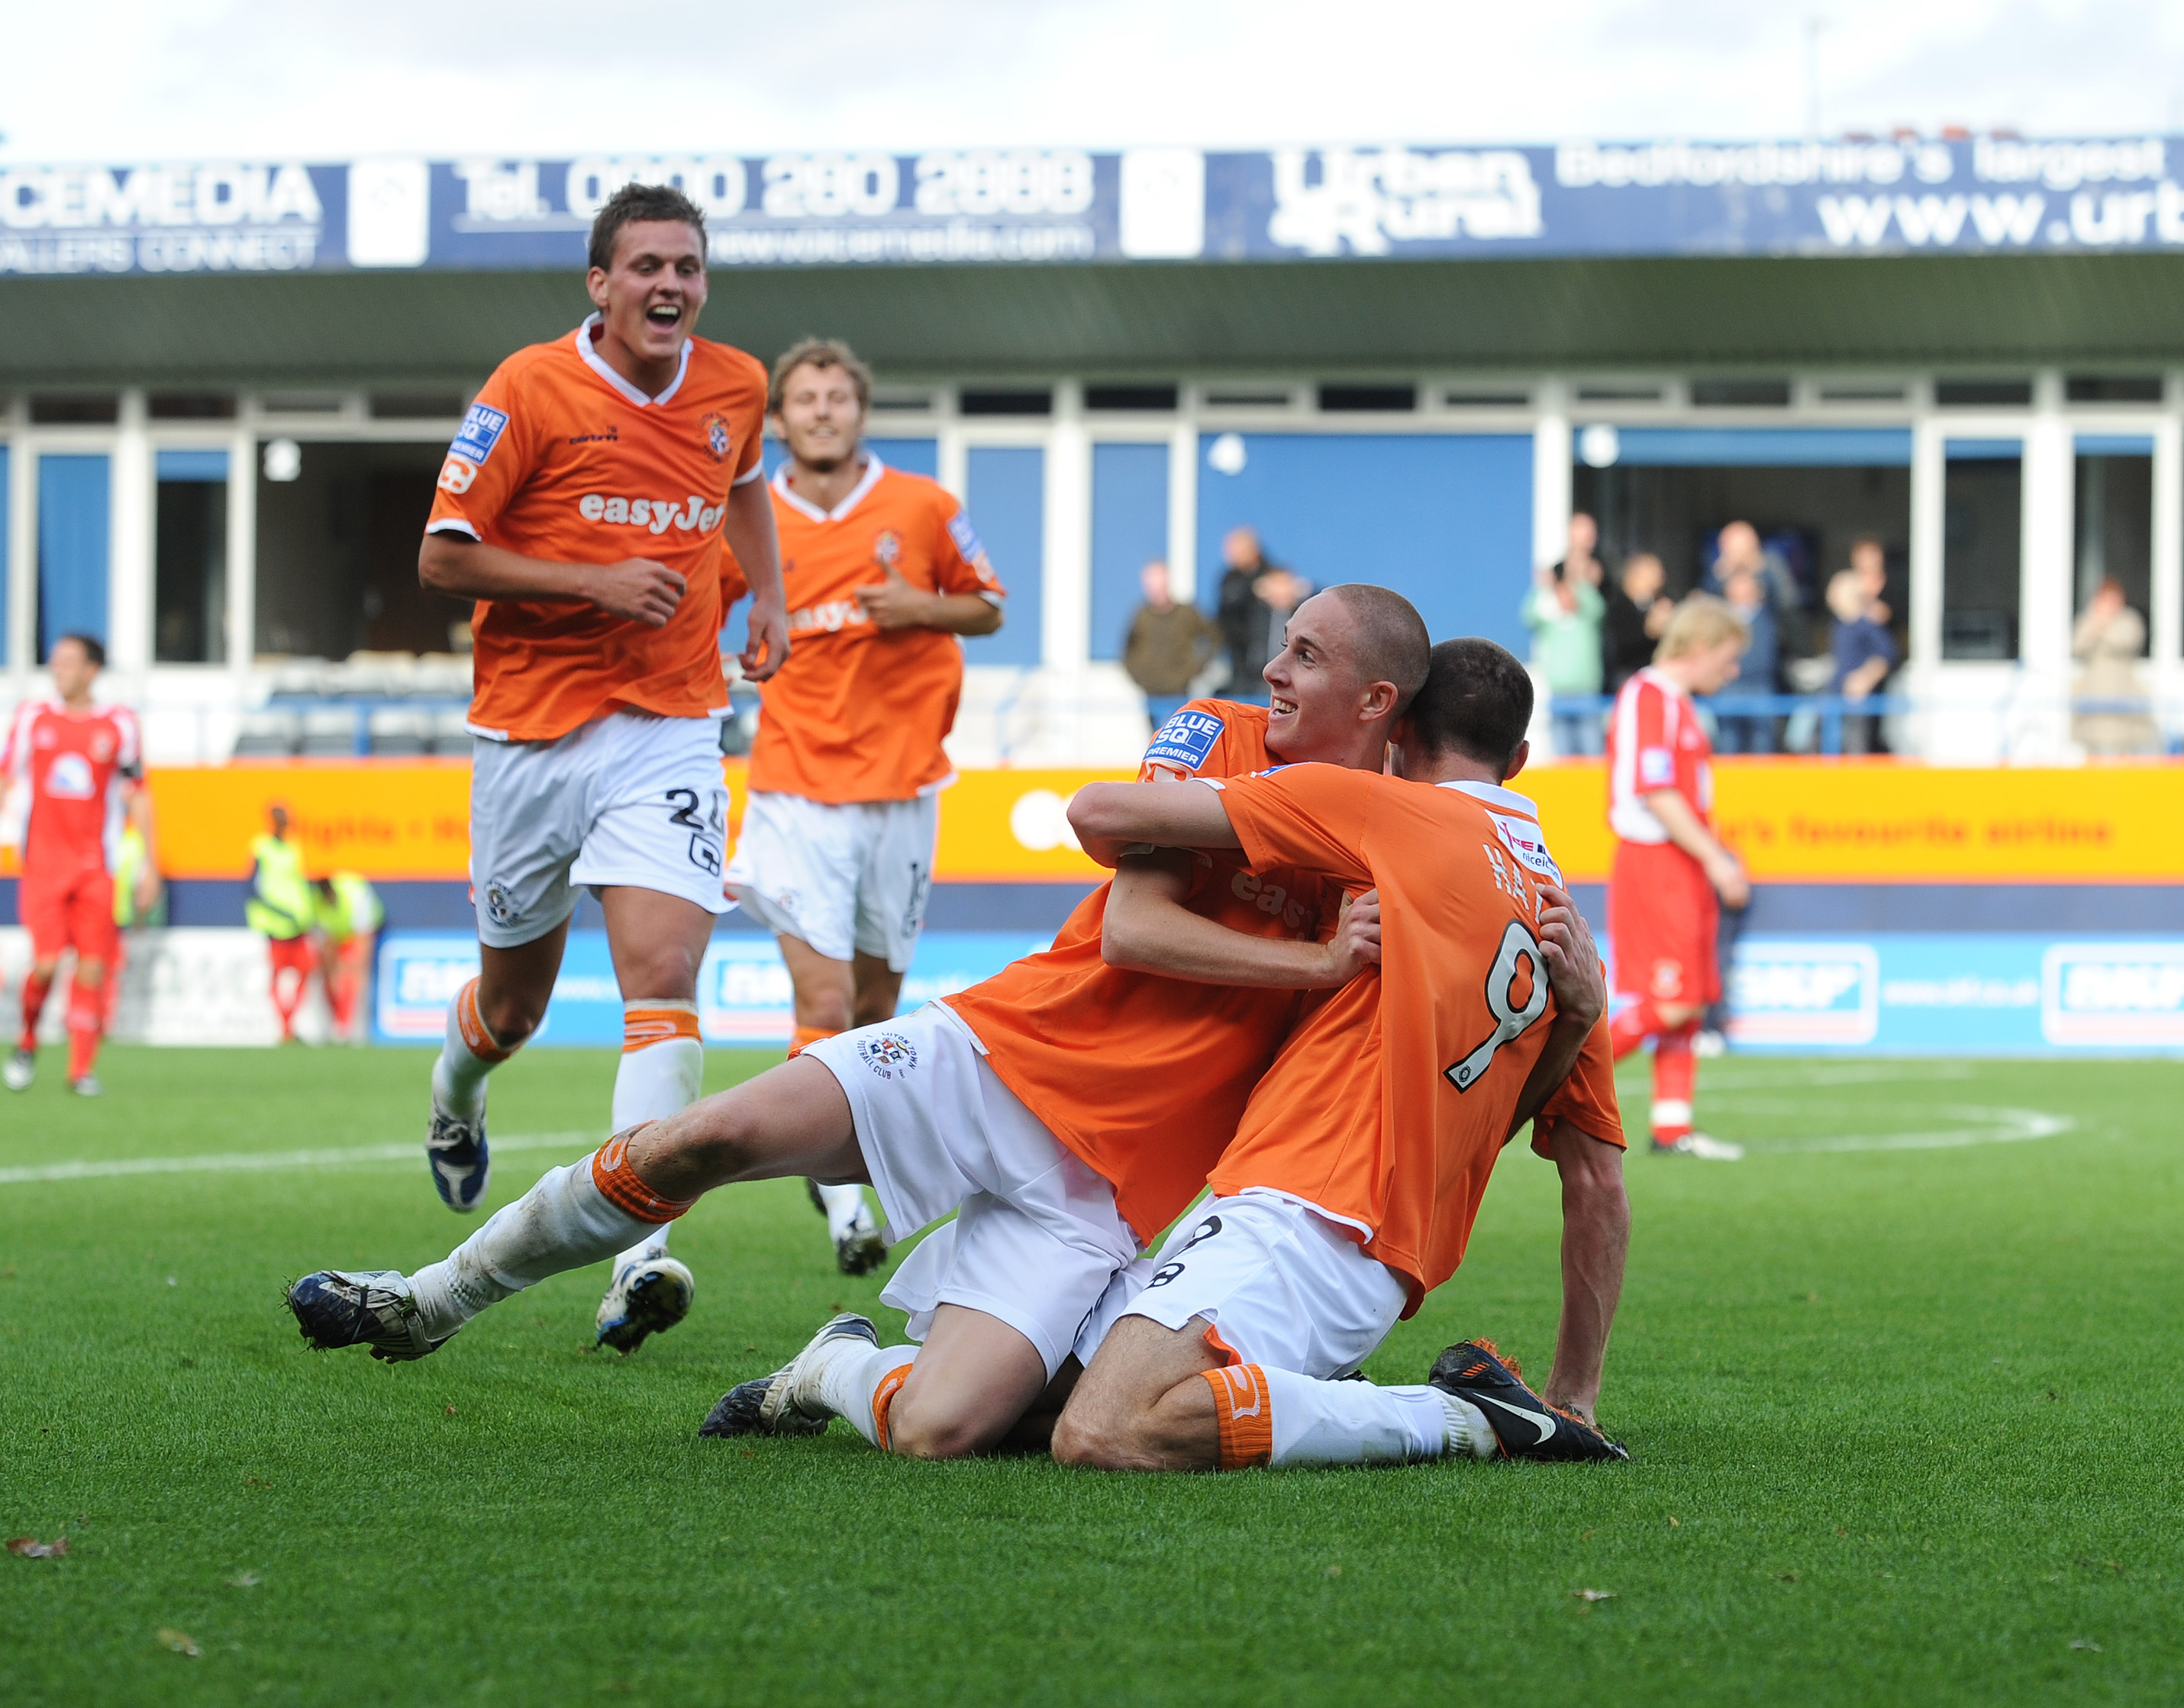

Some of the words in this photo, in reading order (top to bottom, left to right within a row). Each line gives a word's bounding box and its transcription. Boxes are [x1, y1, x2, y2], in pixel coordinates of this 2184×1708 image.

[1555, 139, 1953, 186] Bedfordshire's
[1974, 139, 2165, 191] largest
[763, 152, 899, 217] 280
[1155, 727, 1190, 745] SQ
[1163, 714, 1221, 736] BLUE
[1145, 746, 1200, 765] PREMIER
[1442, 917, 1552, 1094] 9
[907, 1046, 918, 1071] TOWN
[873, 1065, 892, 1080] CLUB
